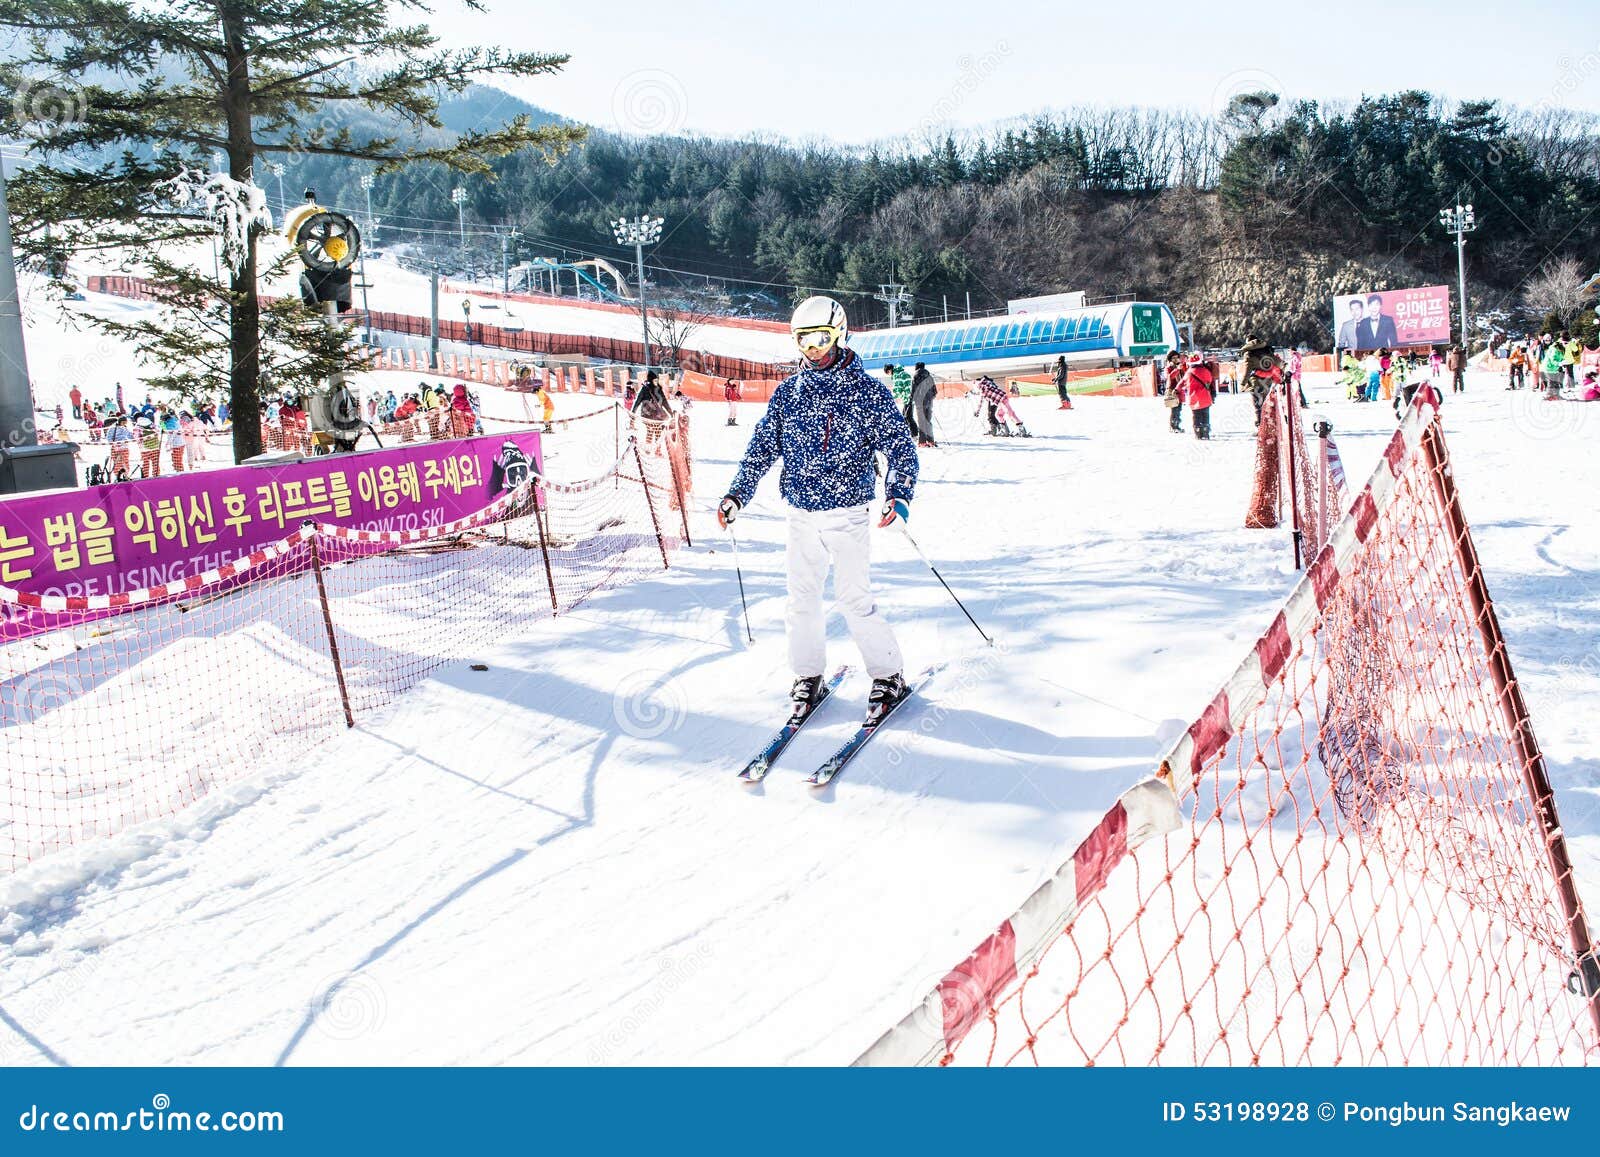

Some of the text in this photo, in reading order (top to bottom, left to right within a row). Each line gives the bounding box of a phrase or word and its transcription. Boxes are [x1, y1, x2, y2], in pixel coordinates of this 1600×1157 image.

[1395, 298, 1444, 319] 위메프
[43, 507, 115, 572] 법을
[124, 491, 217, 554] 익히신
[222, 487, 252, 537] 후
[256, 471, 352, 529] 리프트를
[358, 461, 422, 511] 이용해
[423, 454, 483, 499] 주세요!
[106, 560, 186, 597] USING
[190, 549, 232, 579] THE
[397, 513, 418, 532] TO
[421, 506, 445, 529] SKI
